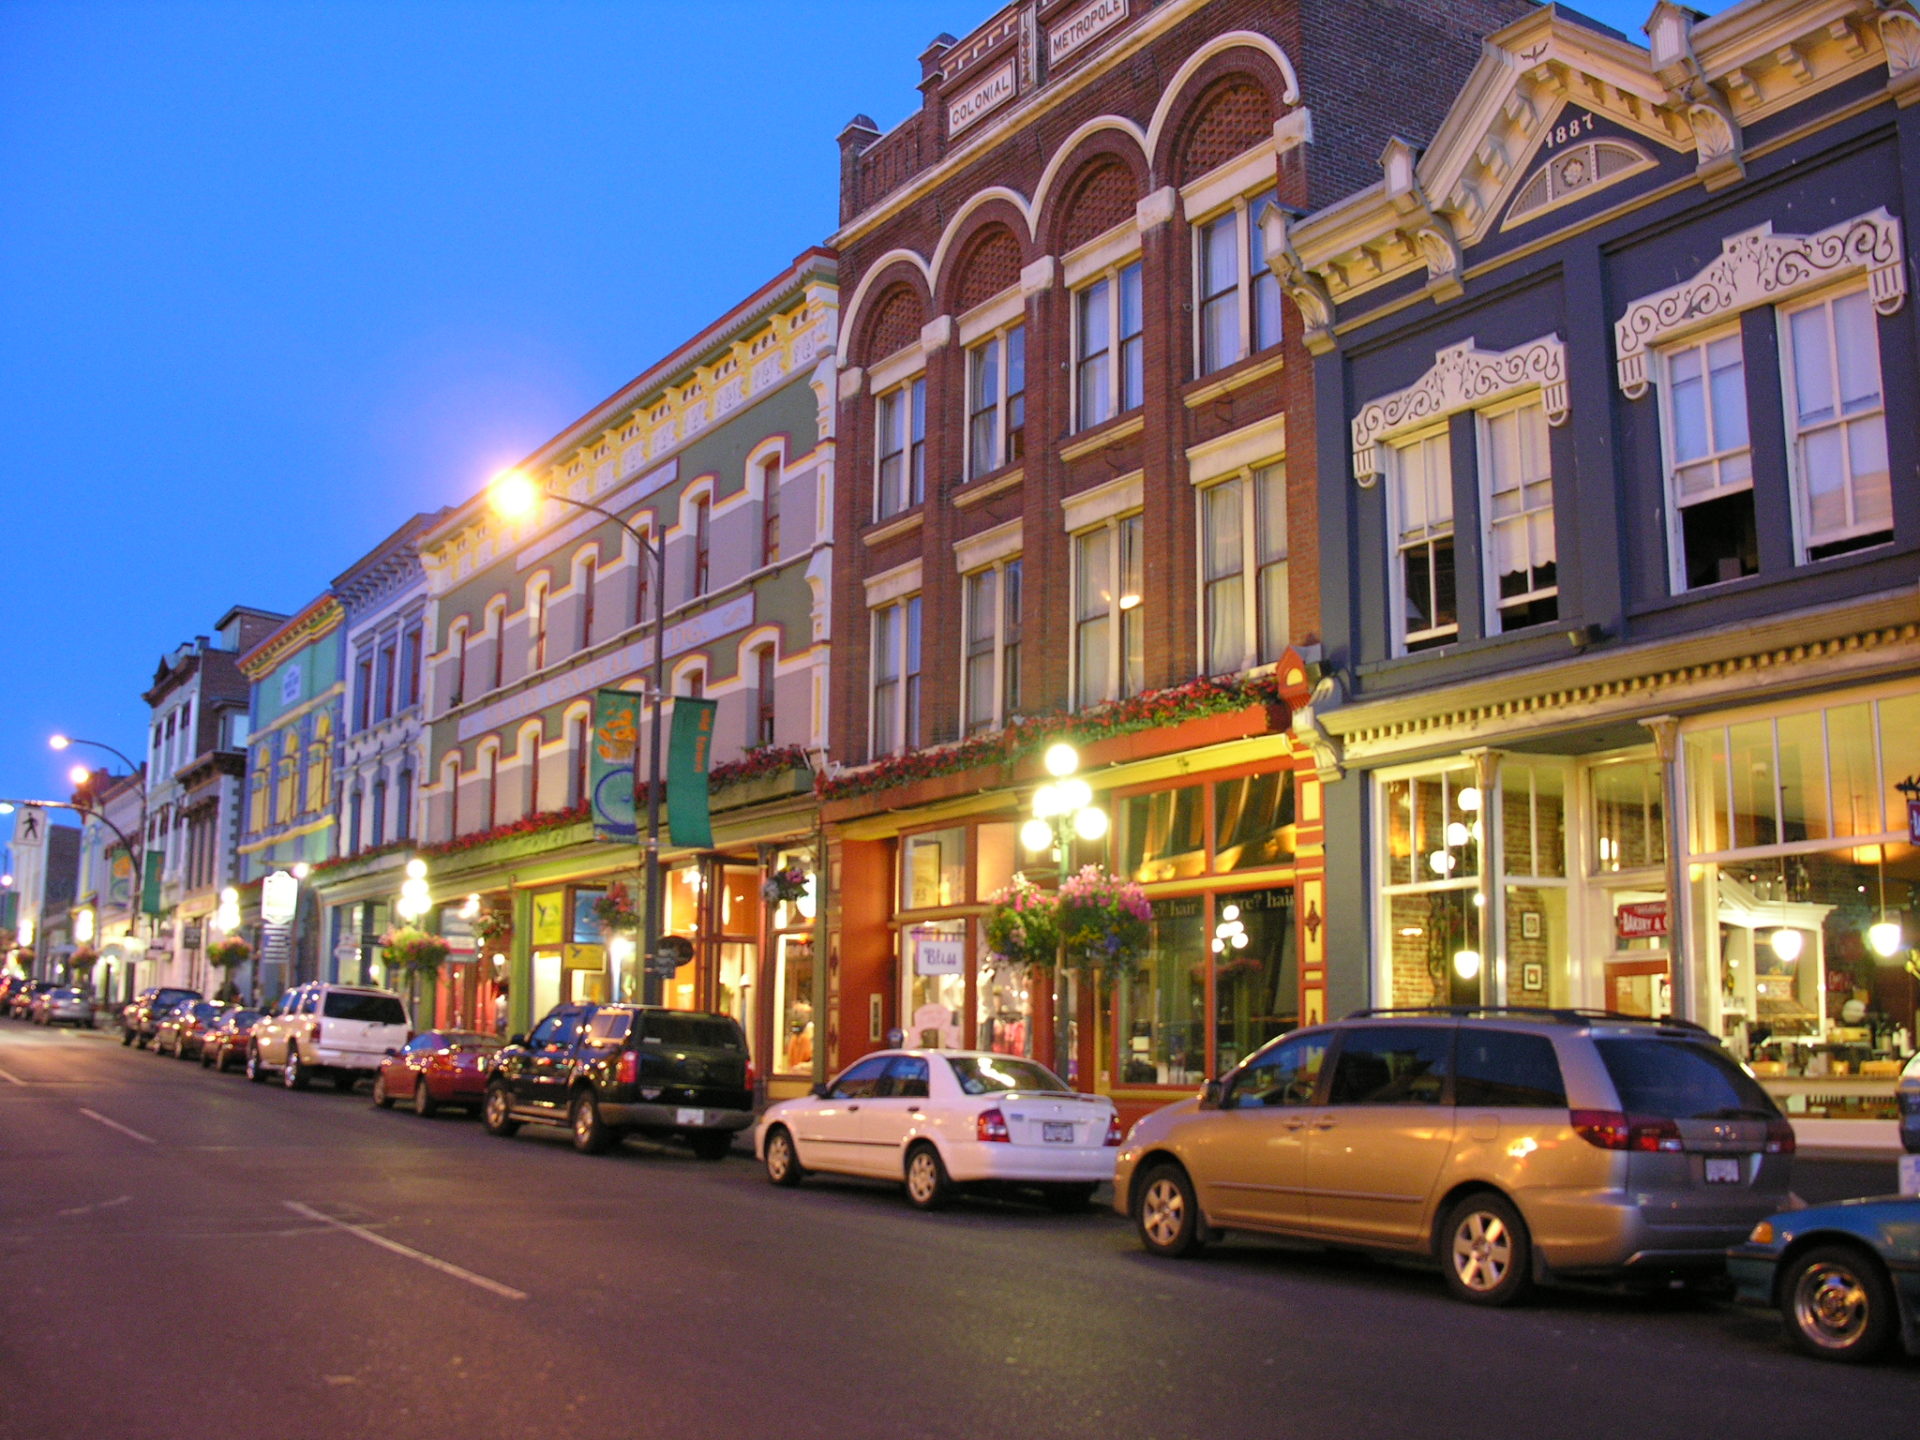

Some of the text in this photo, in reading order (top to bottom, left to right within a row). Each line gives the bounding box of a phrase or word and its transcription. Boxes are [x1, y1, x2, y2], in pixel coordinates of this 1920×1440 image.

[1053, 0, 1121, 54] METROPOLE
[952, 77, 1010, 125] COLONIAL
[1545, 112, 1595, 148] 1887
